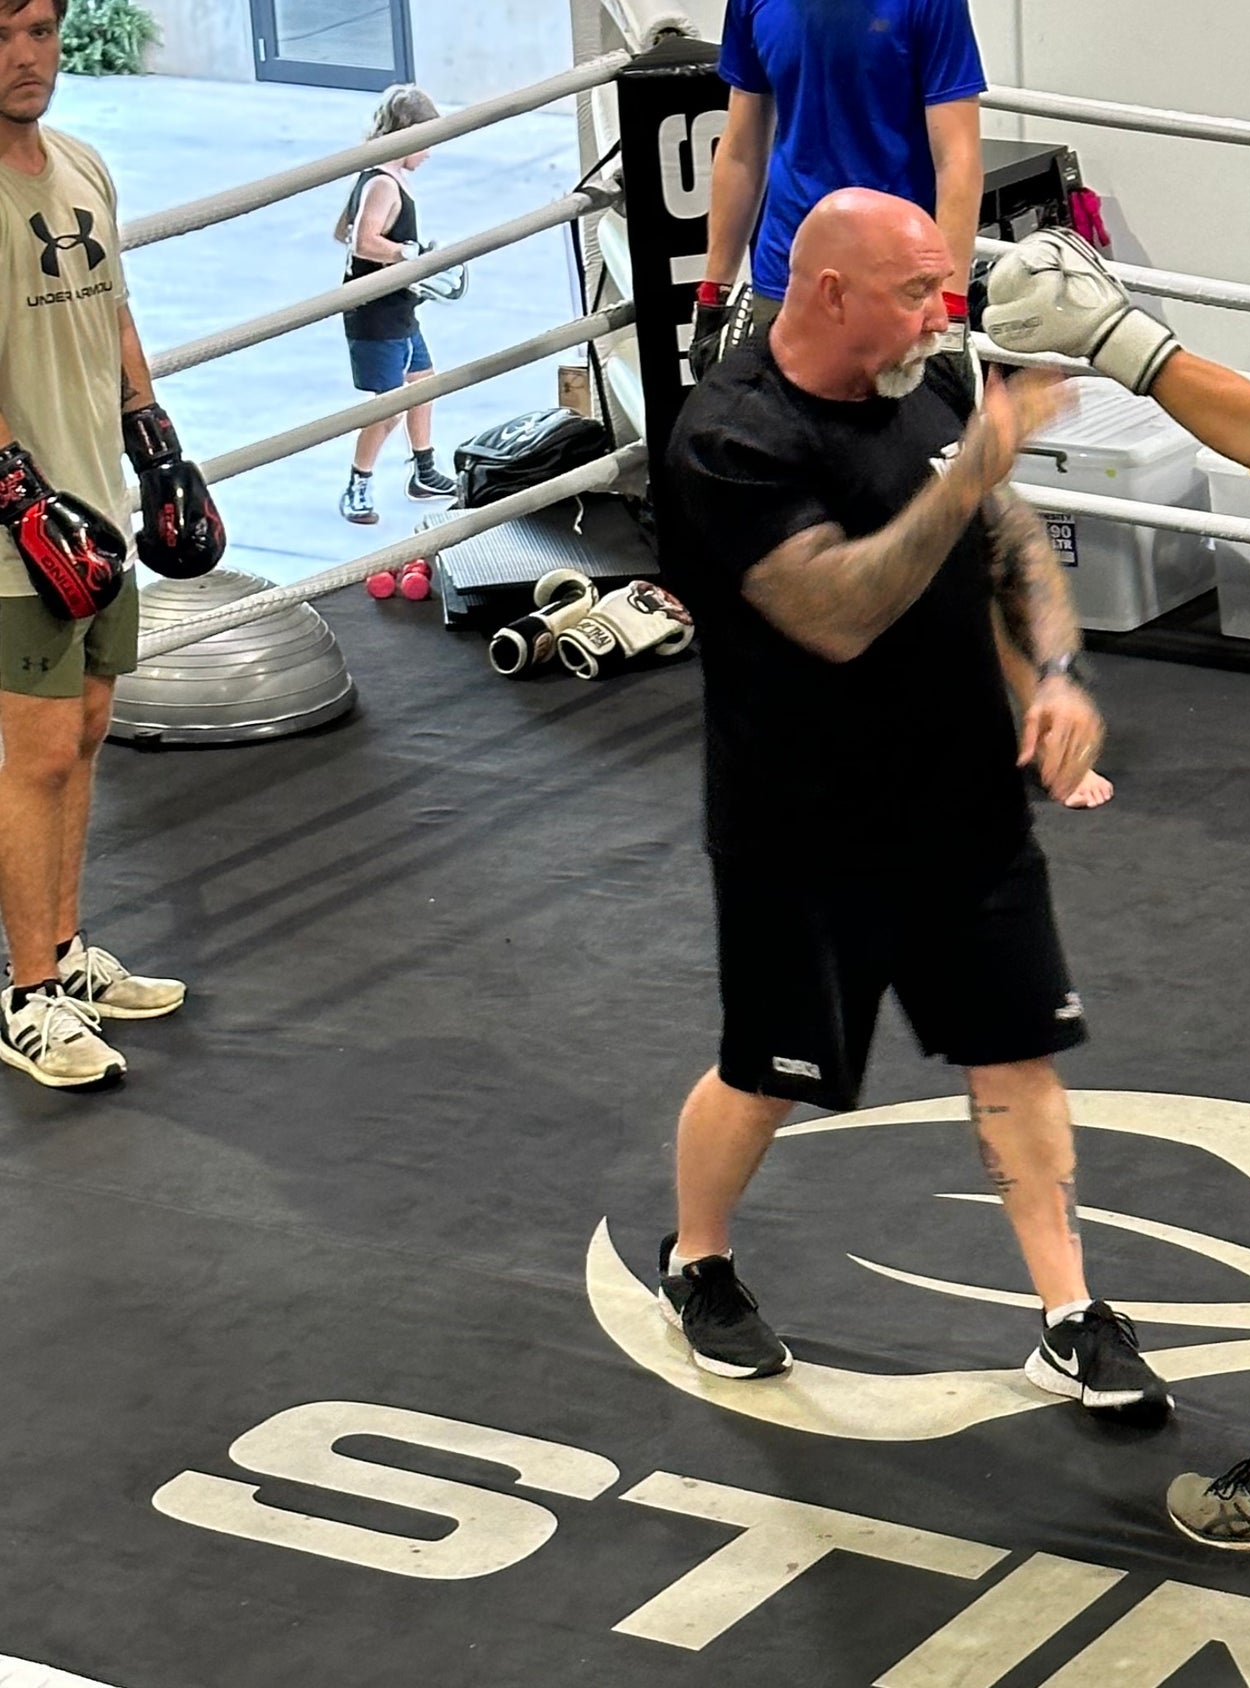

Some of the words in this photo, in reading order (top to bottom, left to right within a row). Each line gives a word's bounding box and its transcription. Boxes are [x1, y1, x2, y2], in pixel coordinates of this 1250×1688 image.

[27, 290, 73, 307] UNDER
[75, 280, 113, 300] ARMOU
[1050, 524, 1072, 539] 90
